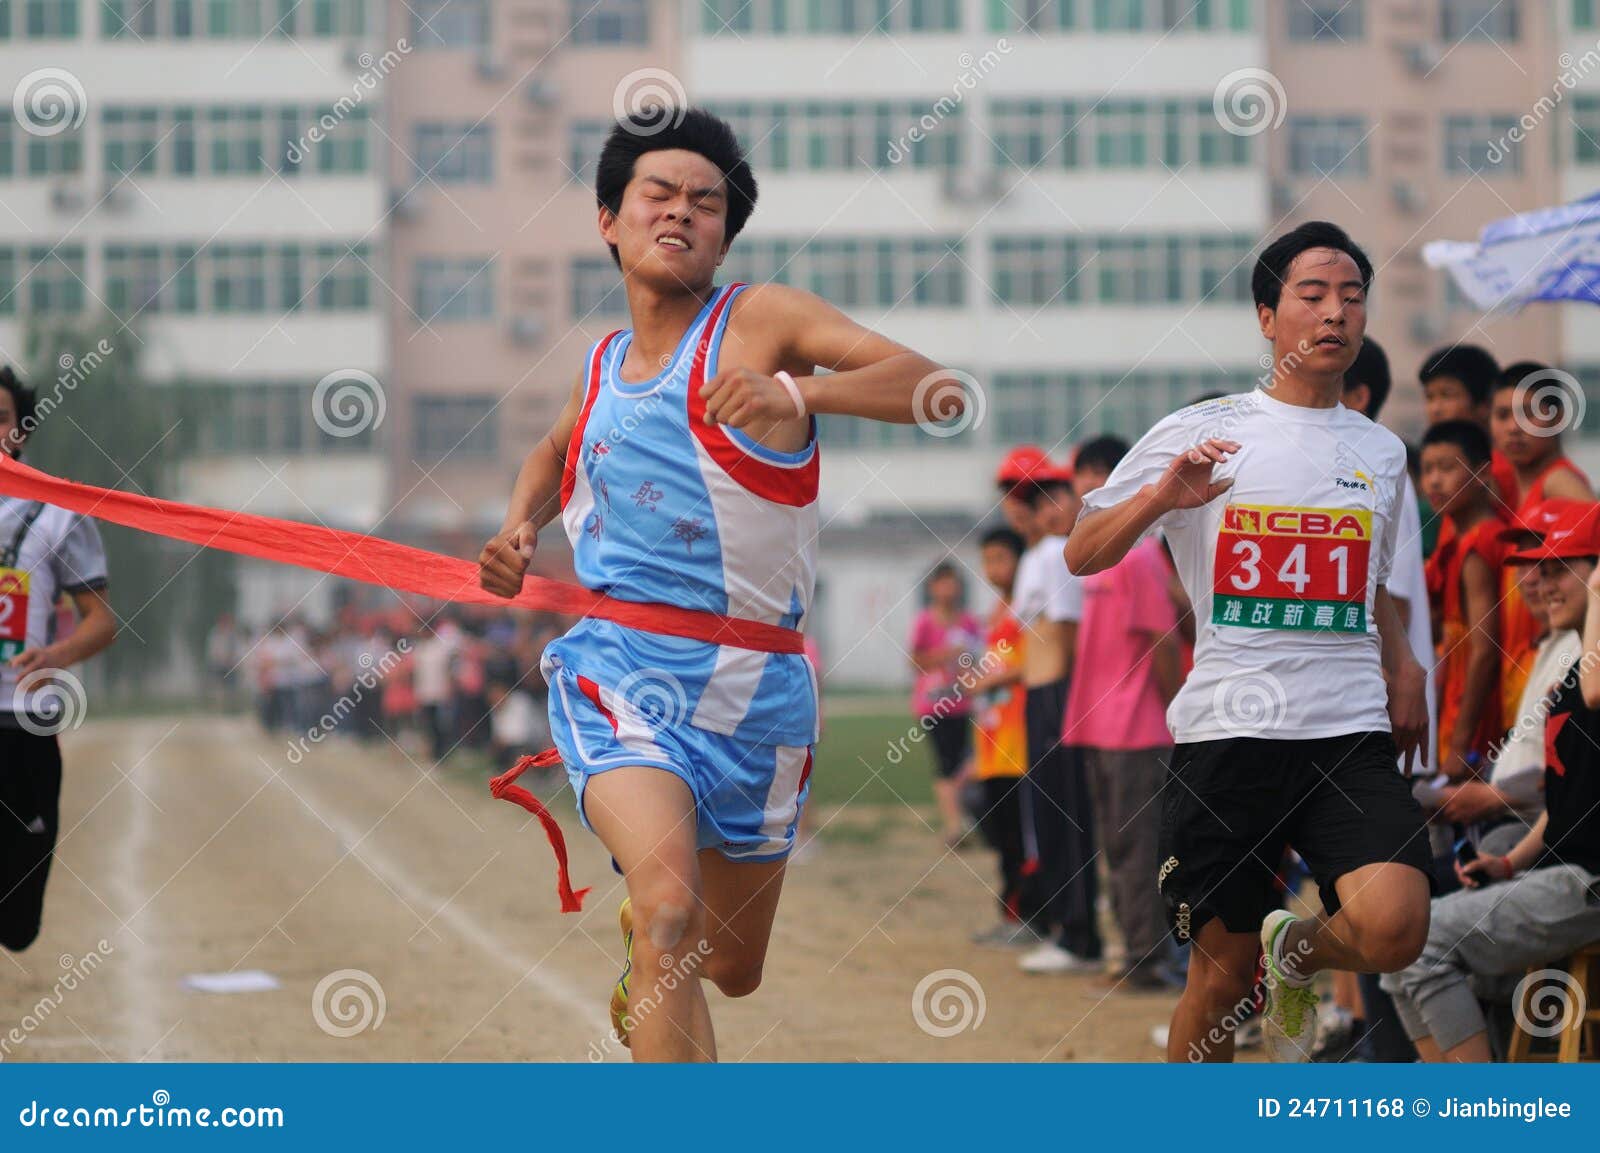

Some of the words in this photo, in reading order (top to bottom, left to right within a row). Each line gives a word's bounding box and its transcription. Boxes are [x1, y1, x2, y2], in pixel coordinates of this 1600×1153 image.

[1266, 511, 1365, 538] CBA
[1230, 539, 1349, 596] 341
[1223, 599, 1360, 629] 挑战新高度
